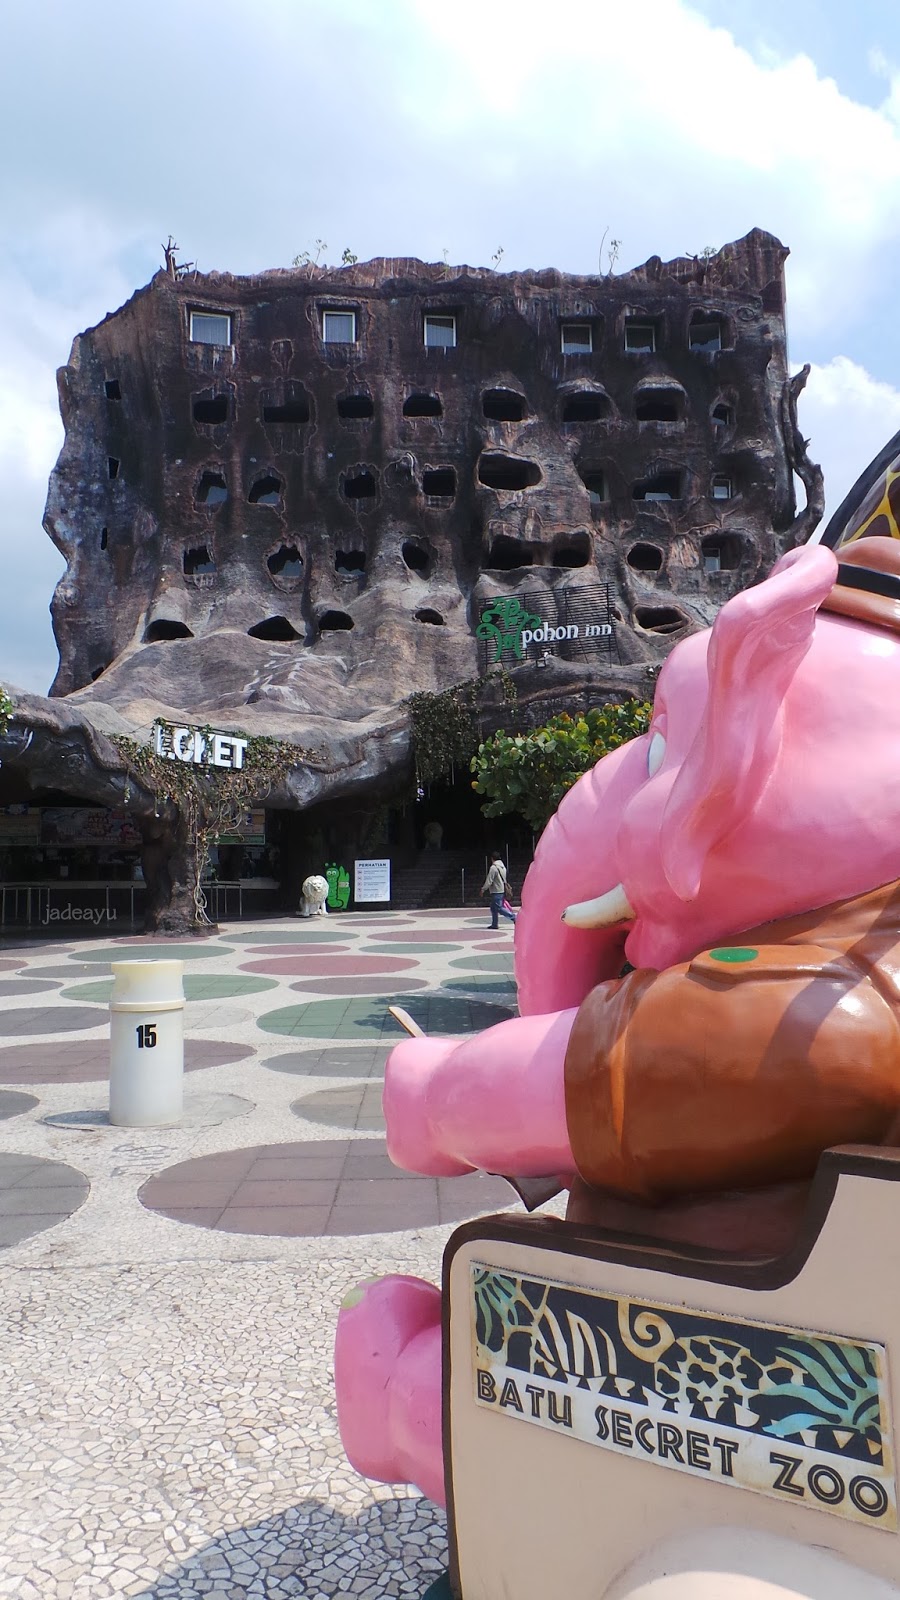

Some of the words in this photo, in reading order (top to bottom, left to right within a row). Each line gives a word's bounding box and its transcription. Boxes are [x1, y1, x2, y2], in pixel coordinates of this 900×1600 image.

[521, 622, 579, 649] pohon
[585, 623, 612, 636] inn
[136, 1023, 157, 1048] 15
[477, 1368, 573, 1429] BATU
[594, 1404, 740, 1478] SECRET
[769, 1451, 889, 1518] ZOO
